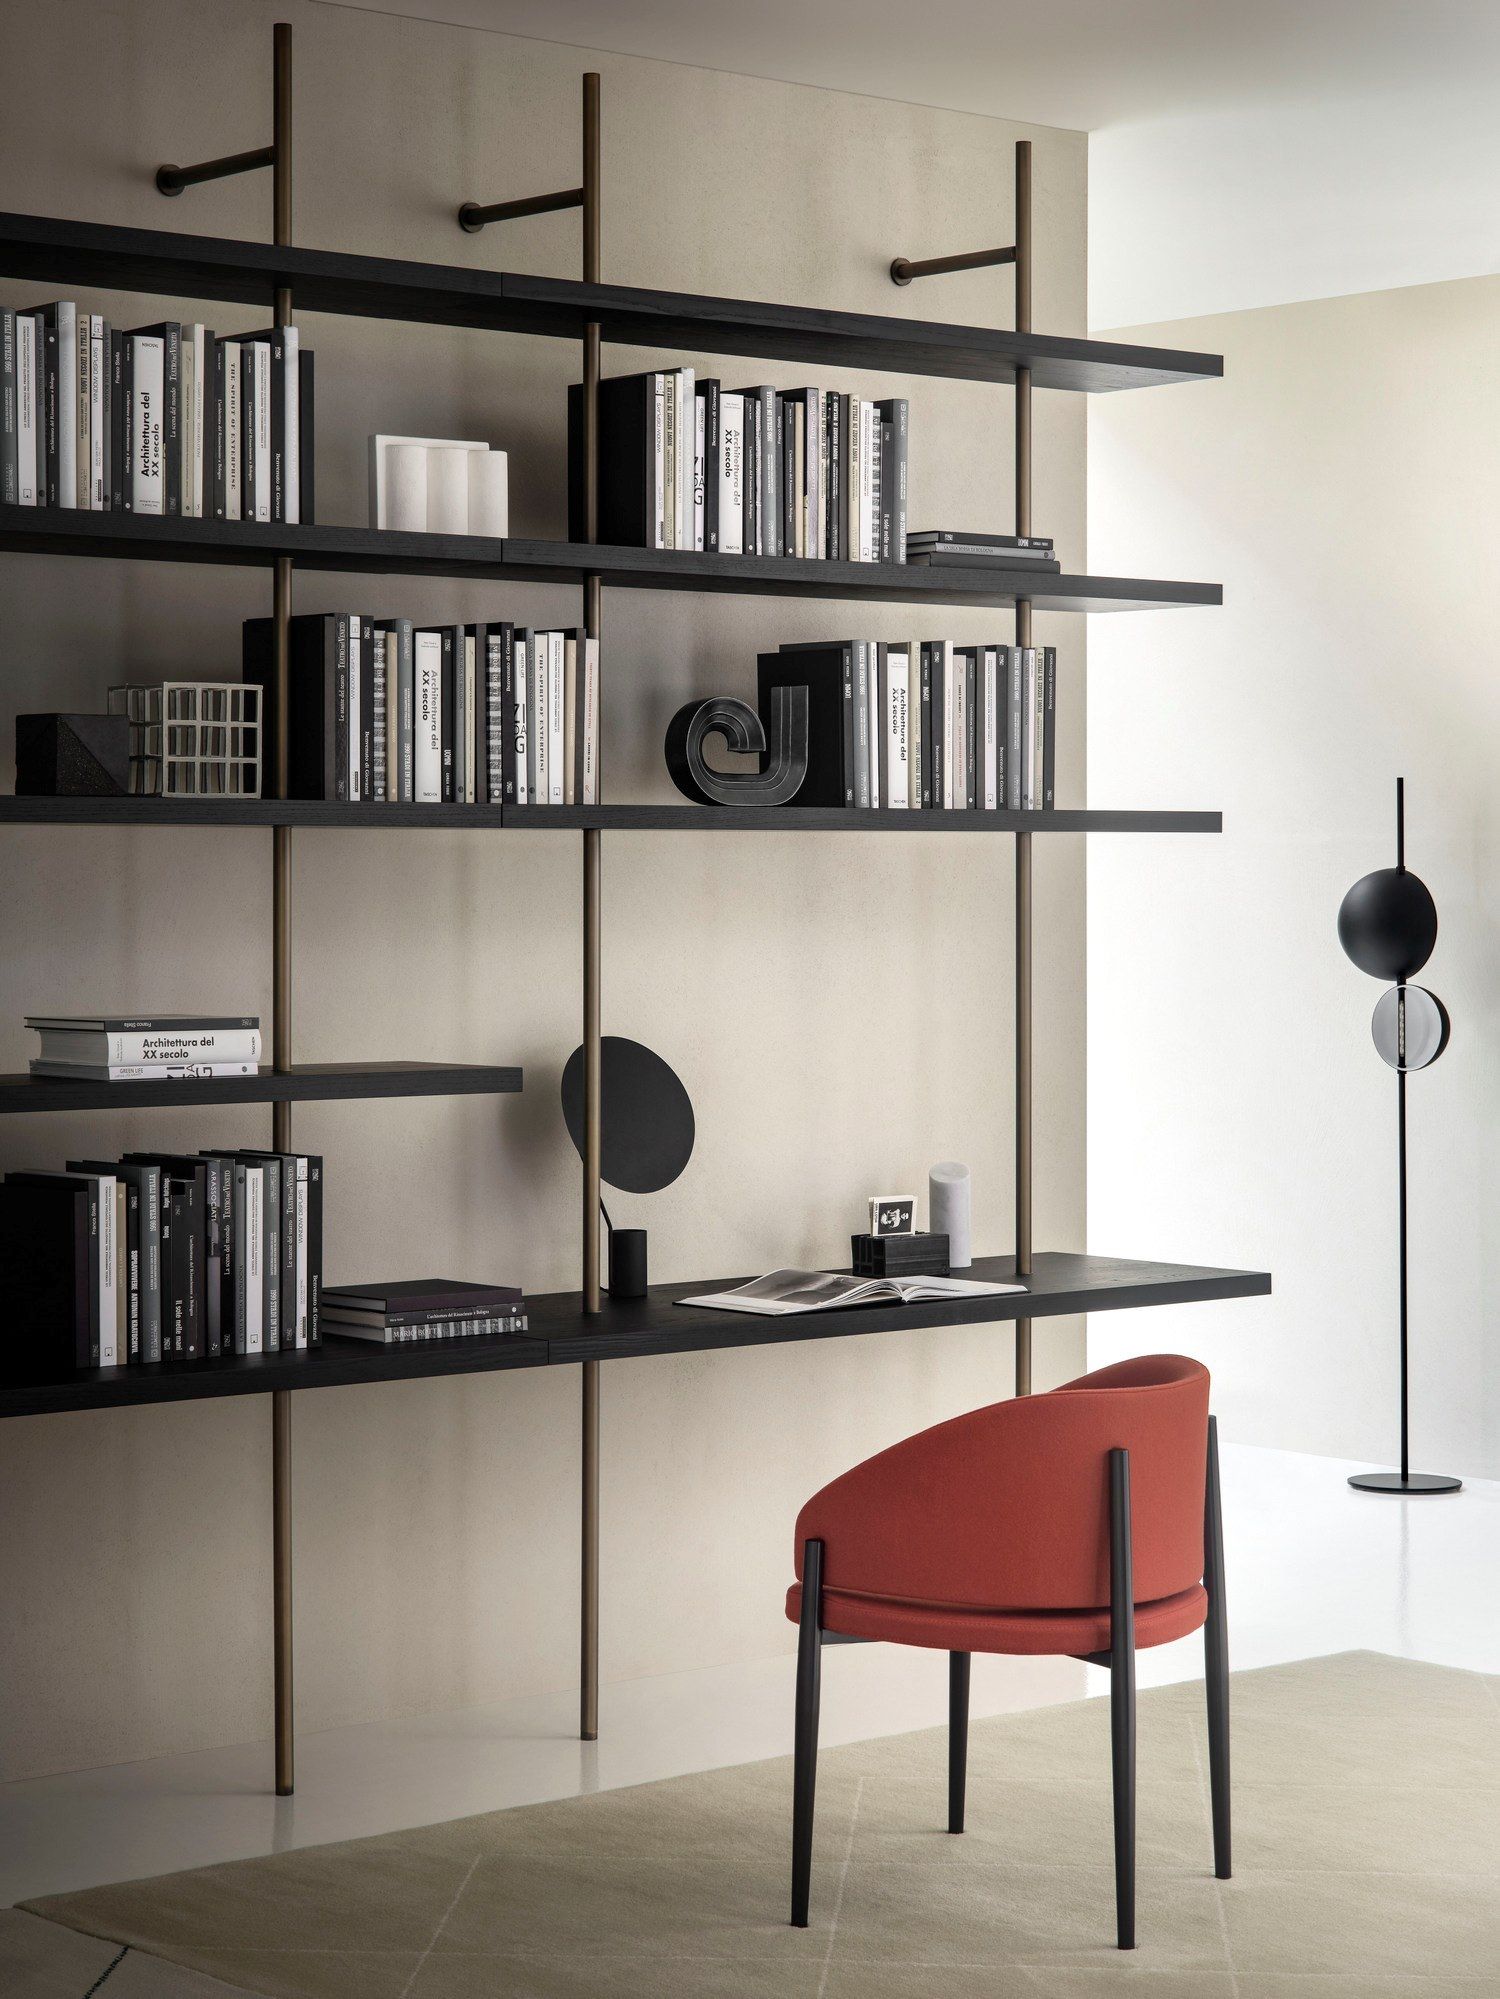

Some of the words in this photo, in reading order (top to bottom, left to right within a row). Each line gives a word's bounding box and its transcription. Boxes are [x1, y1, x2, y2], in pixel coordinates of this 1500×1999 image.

[140, 392, 150, 410] del
[230, 418, 236, 430] OF
[140, 412, 150, 478] Architettura
[151, 424, 160, 458] secolo
[725, 429, 732, 444] XX
[151, 460, 160, 478] XX
[274, 453, 282, 484] Benvenuto
[274, 492, 282, 519] Giovanni
[422, 670, 430, 686] XX
[430, 670, 438, 731] Architettura
[892, 688, 898, 702] XX
[422, 688, 430, 721] secolo
[538, 706, 544, 718] OF
[430, 733, 438, 750] del
[142, 1038, 198, 1048] Architettura
[199, 1036, 214, 1047] del
[142, 1050, 158, 1060] XX
[159, 1049, 189, 1059] secolo
[286, 1166, 294, 1186] VENETO
[286, 1192, 294, 1214] TEATRO
[286, 1220, 294, 1233] teatro
[286, 1234, 294, 1243] del
[286, 1244, 294, 1261] stanze
[130, 1250, 138, 1291] SOPRAVVIVERE
[130, 1292, 138, 1319] ANTONIN
[175, 1305, 183, 1318] sole
[175, 1319, 183, 1334] nelle
[393, 1328, 417, 1338] MARIO
[418, 1327, 442, 1336] BOTTA
[130, 1320, 138, 1354] KRATOCHVIL
[175, 1336, 183, 1350] mani
